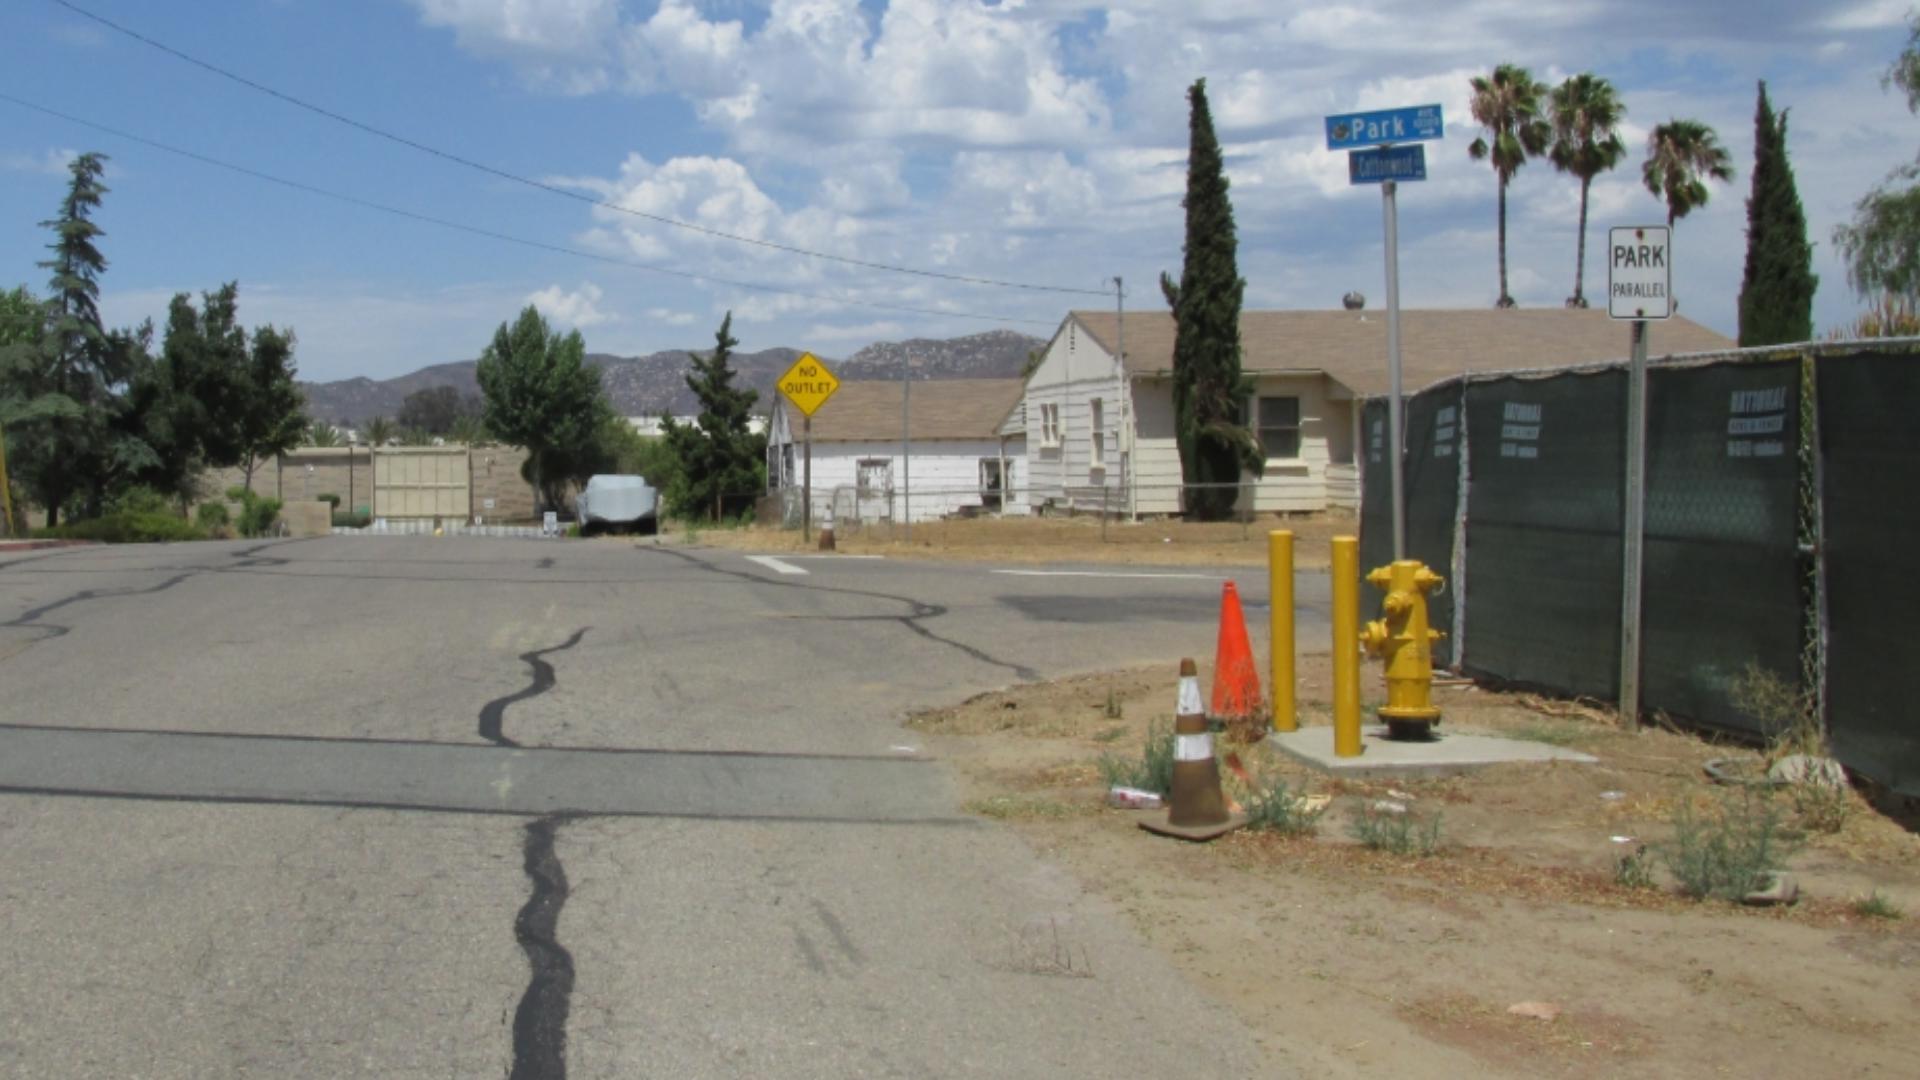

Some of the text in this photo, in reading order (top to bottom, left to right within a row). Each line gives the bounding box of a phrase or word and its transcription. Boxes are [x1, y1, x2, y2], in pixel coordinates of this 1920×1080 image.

[1352, 115, 1405, 140] Park
[1614, 245, 1665, 268] PARK
[1612, 282, 1666, 298] PARALLEL
[799, 366, 817, 377] NO
[784, 382, 831, 394] OUTLET
